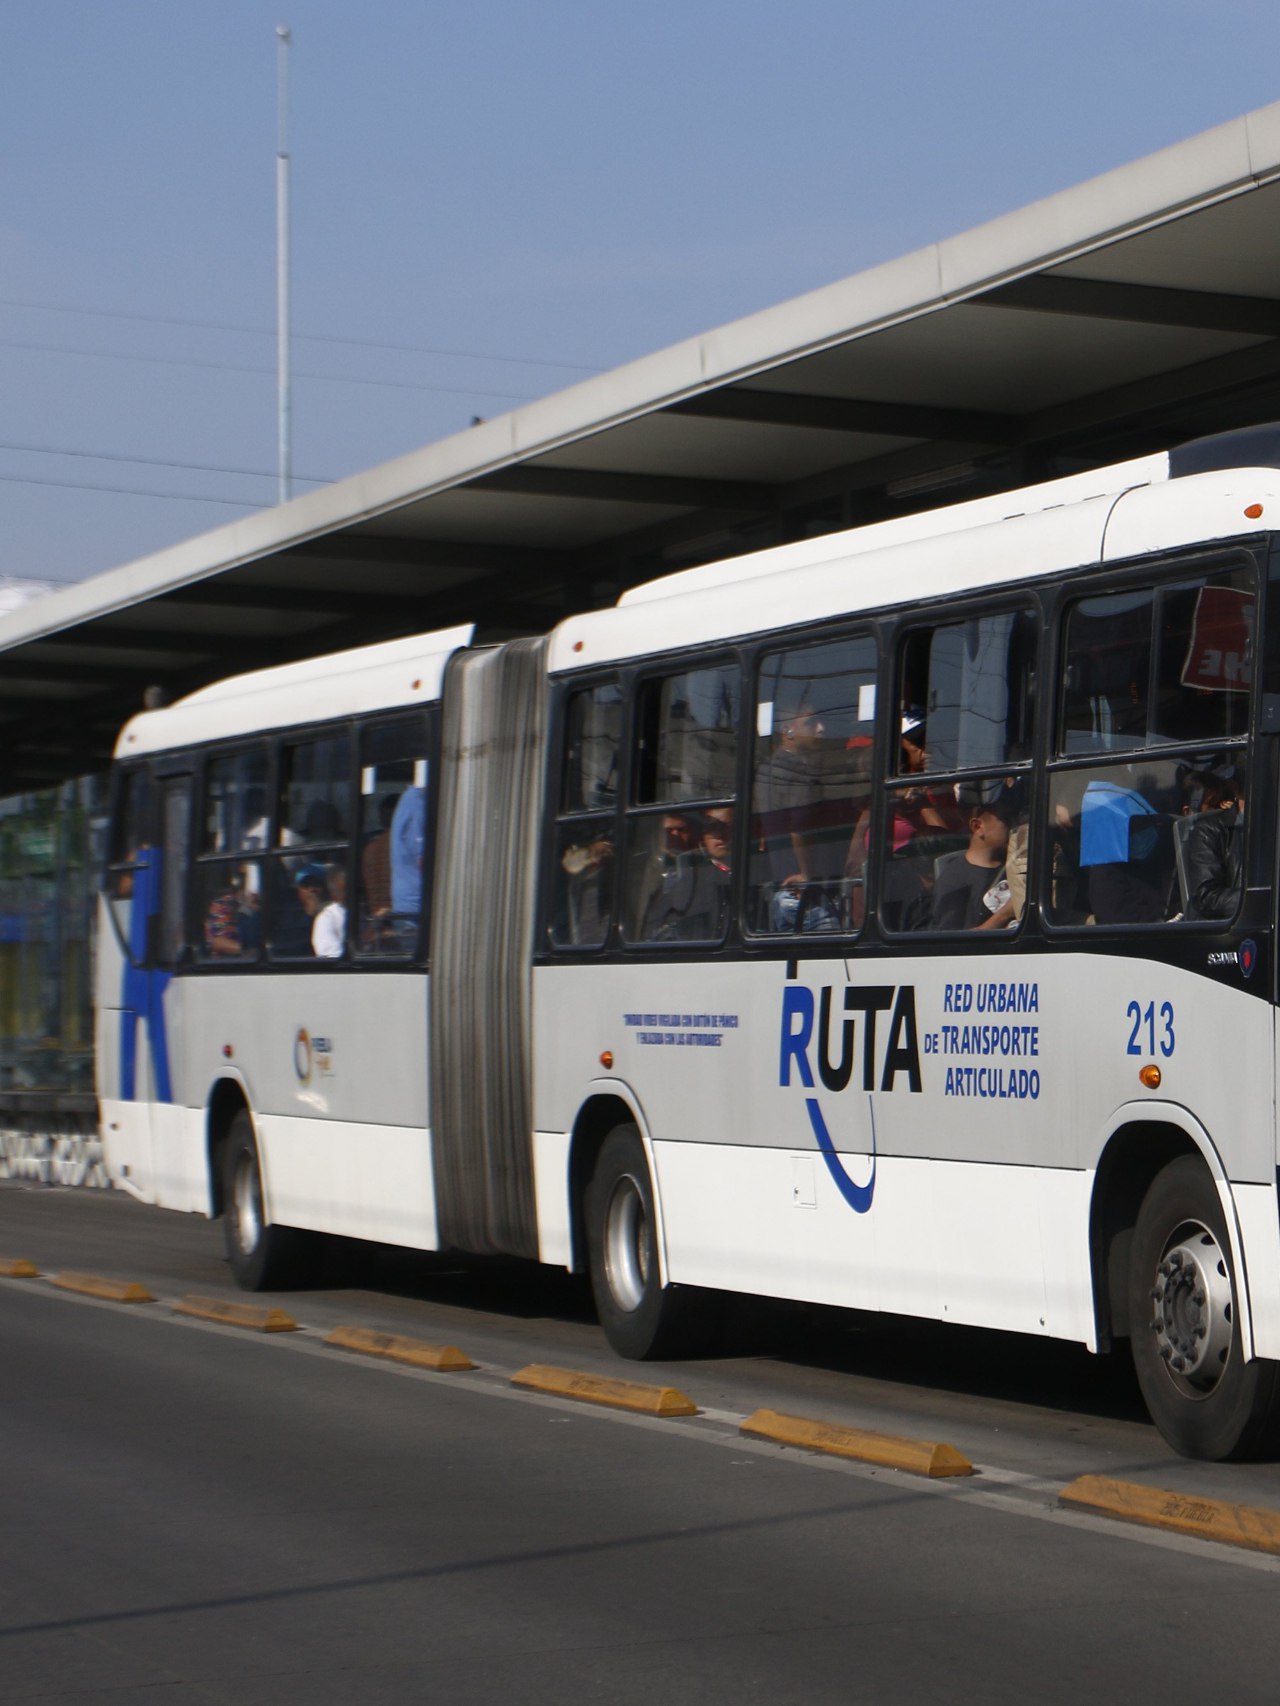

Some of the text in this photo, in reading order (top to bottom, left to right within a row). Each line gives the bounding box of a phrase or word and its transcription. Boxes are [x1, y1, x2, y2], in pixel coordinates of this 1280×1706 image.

[943, 983, 1039, 1013] RED URBANA
[779, 985, 922, 1093] RUTA
[924, 1025, 1039, 1056] DE TRANSPORTE
[1126, 1000, 1175, 1057] 213
[944, 1067, 1040, 1100] ARTICULADO
